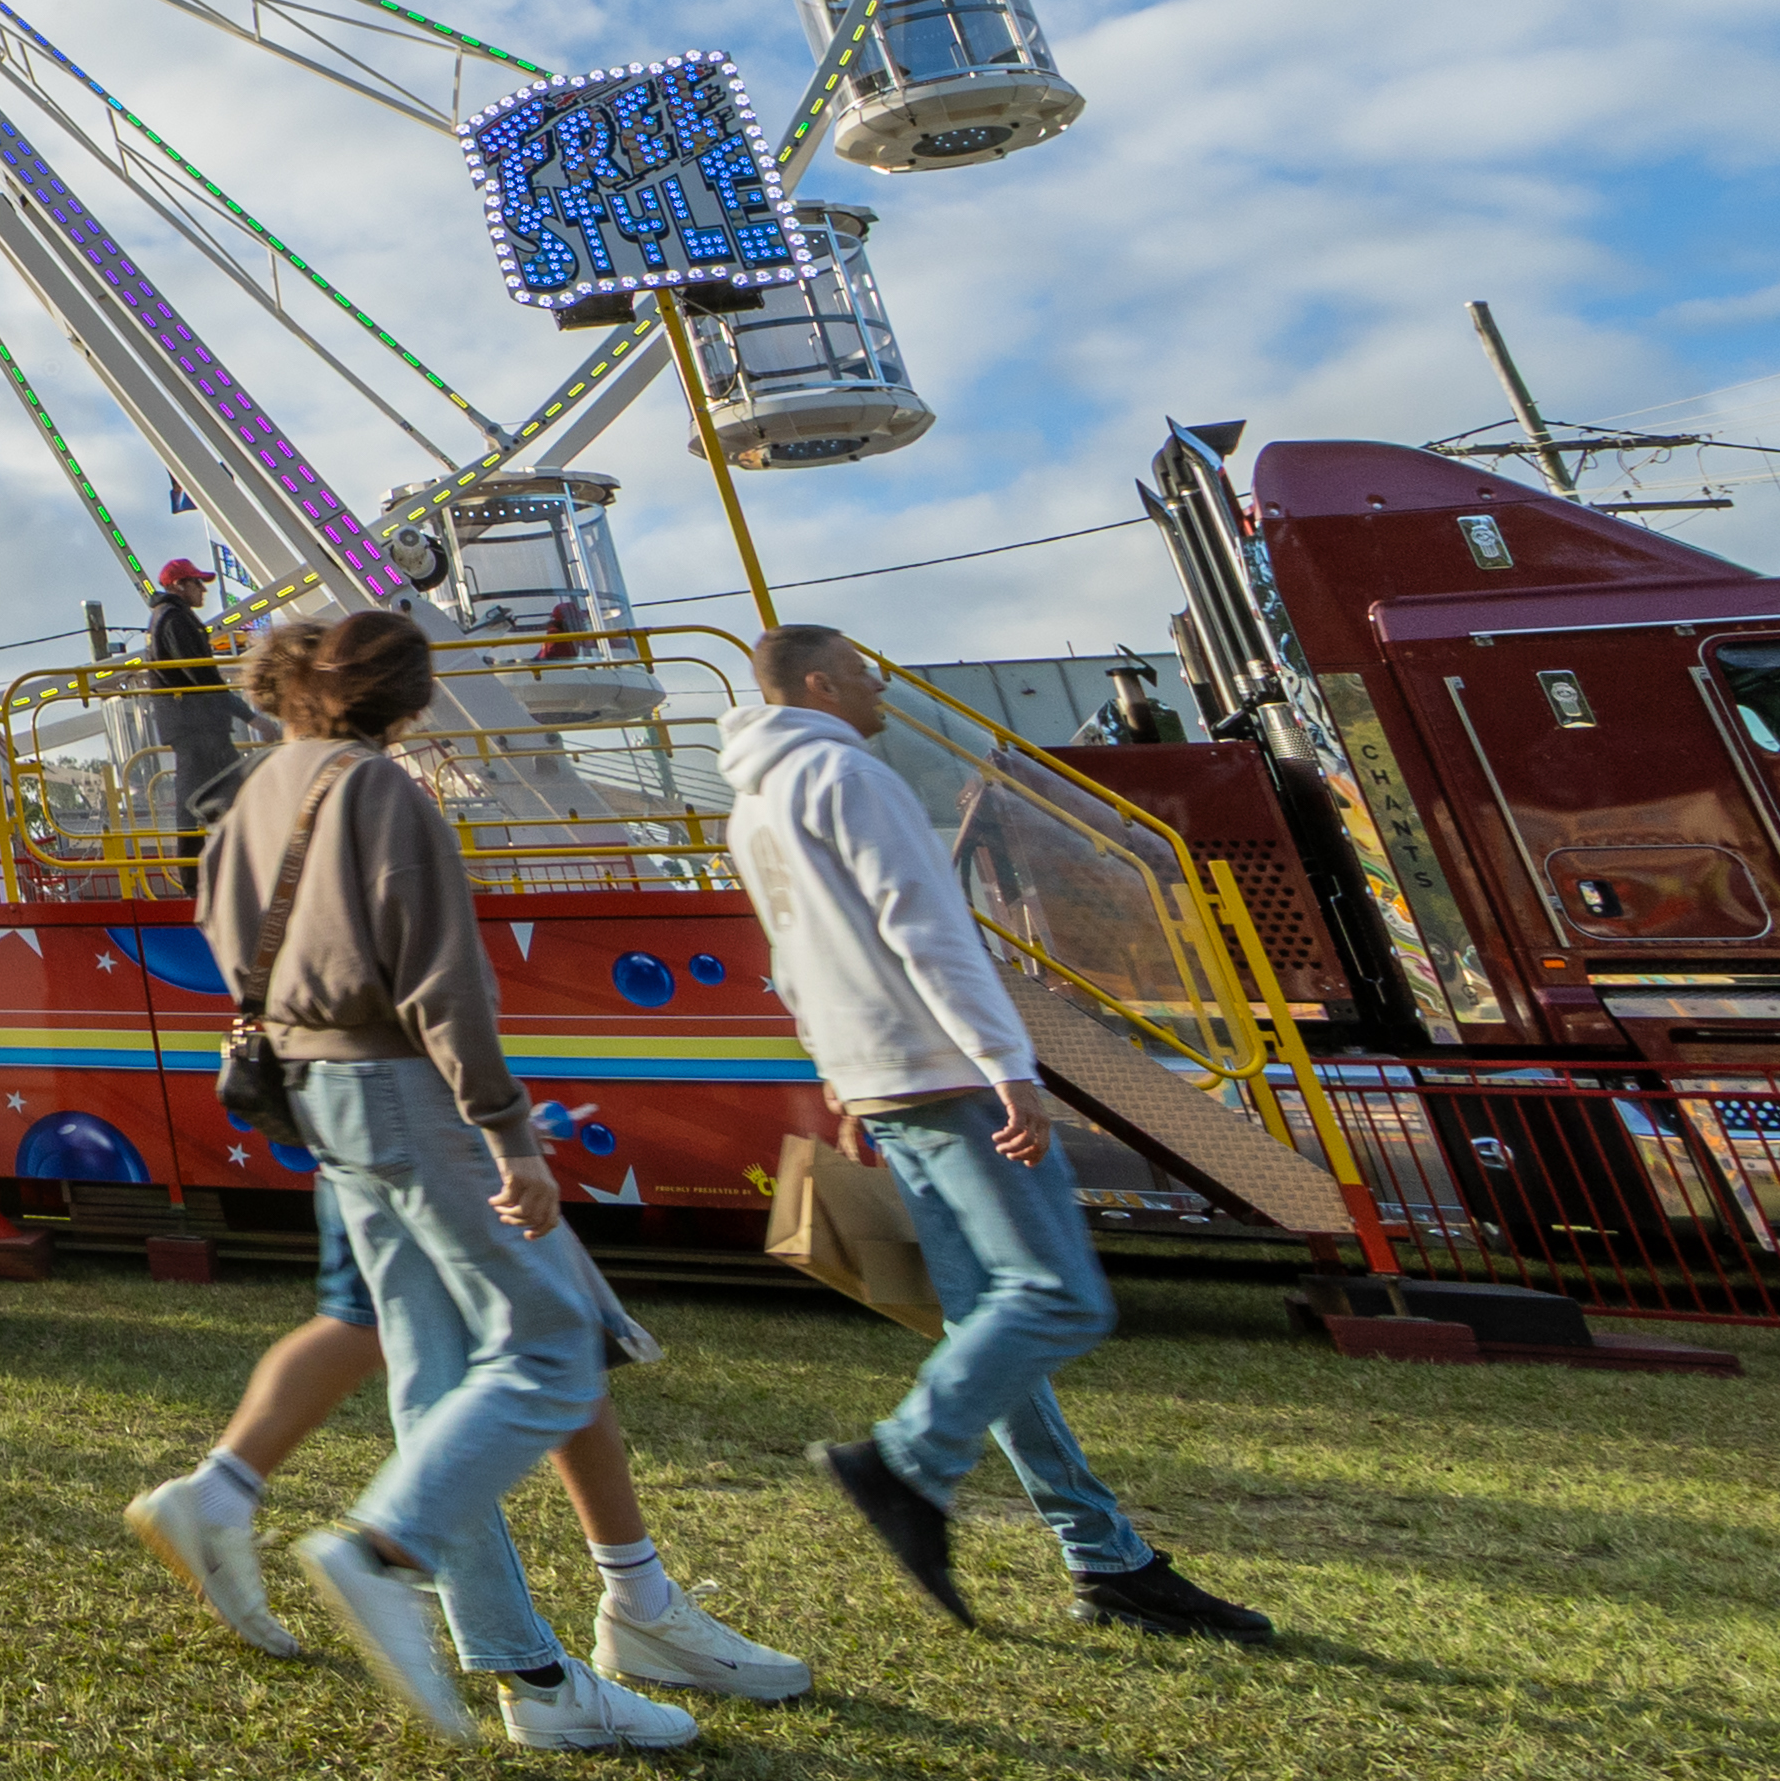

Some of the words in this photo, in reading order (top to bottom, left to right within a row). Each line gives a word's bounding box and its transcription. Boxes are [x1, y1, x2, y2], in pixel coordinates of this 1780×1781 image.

[478, 62, 734, 212] FREE
[503, 133, 789, 292] STYLE
[1361, 744, 1433, 888] CHANTS
